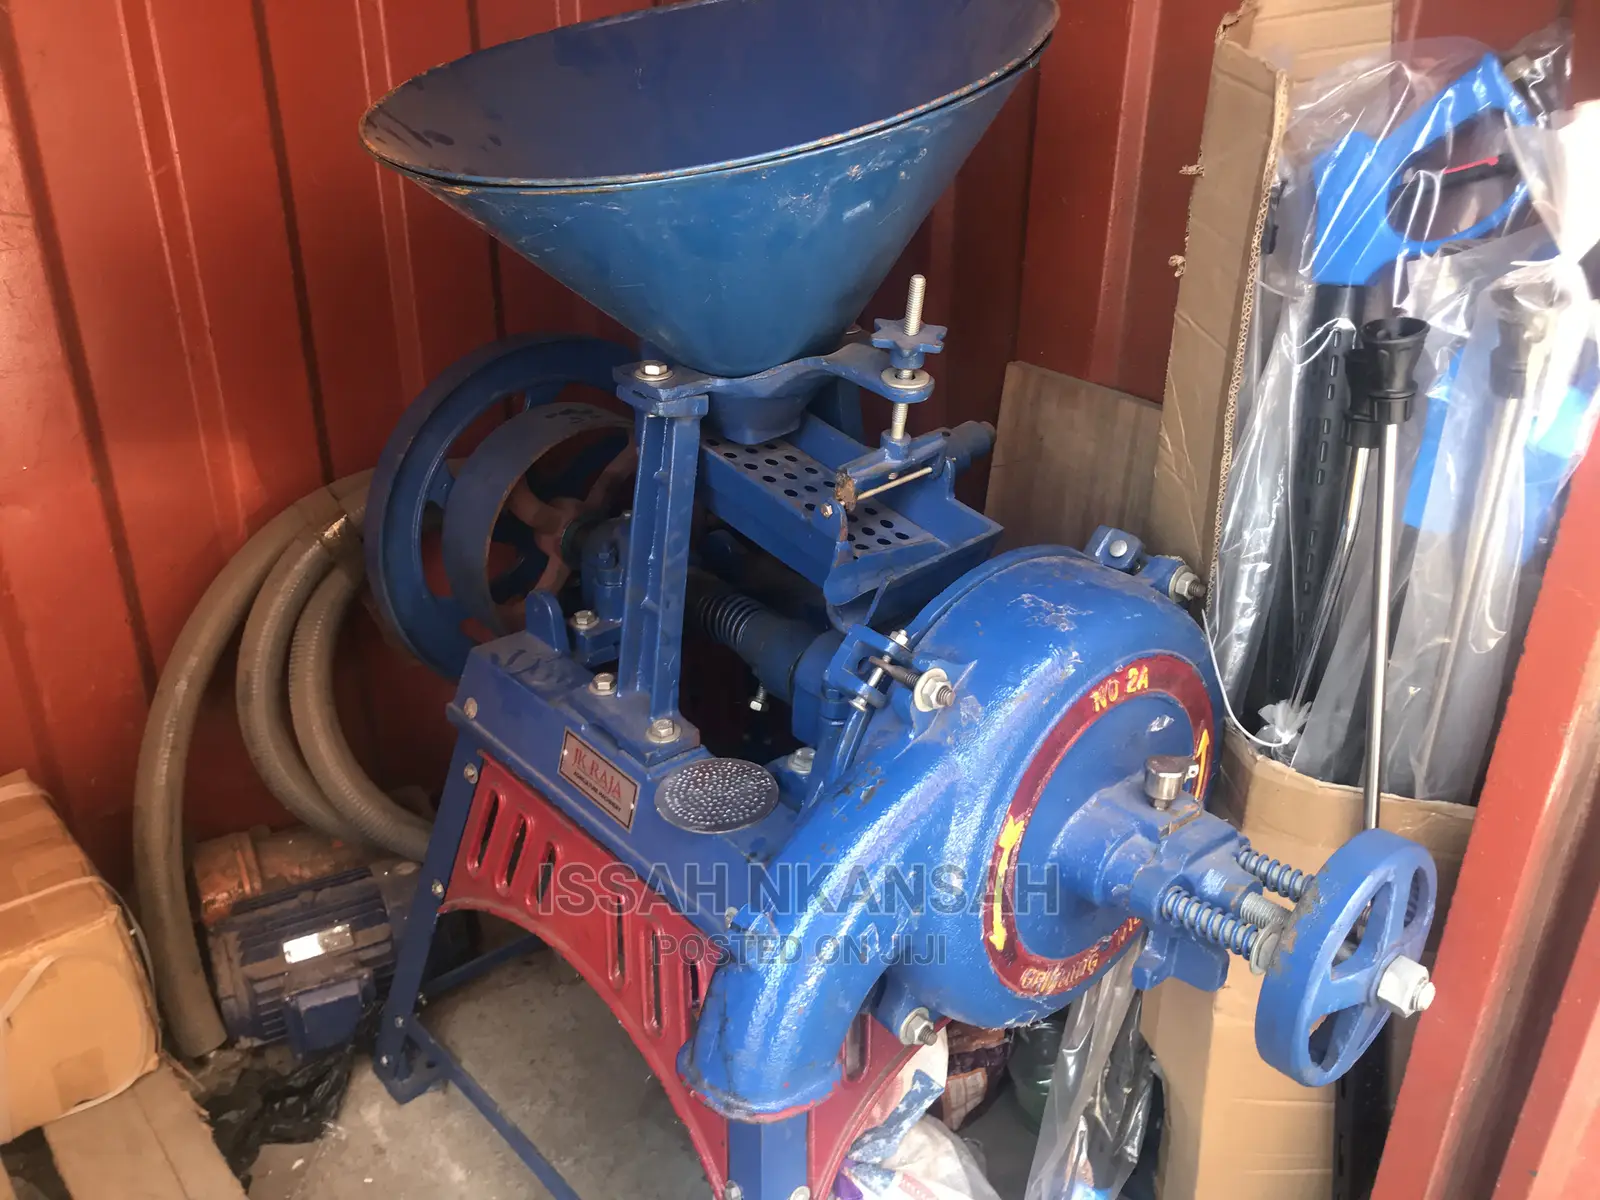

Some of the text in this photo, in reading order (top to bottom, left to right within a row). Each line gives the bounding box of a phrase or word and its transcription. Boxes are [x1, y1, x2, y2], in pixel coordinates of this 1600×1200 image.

[1127, 665, 1148, 693] 2A
[572, 748, 622, 799] JK RAJA
